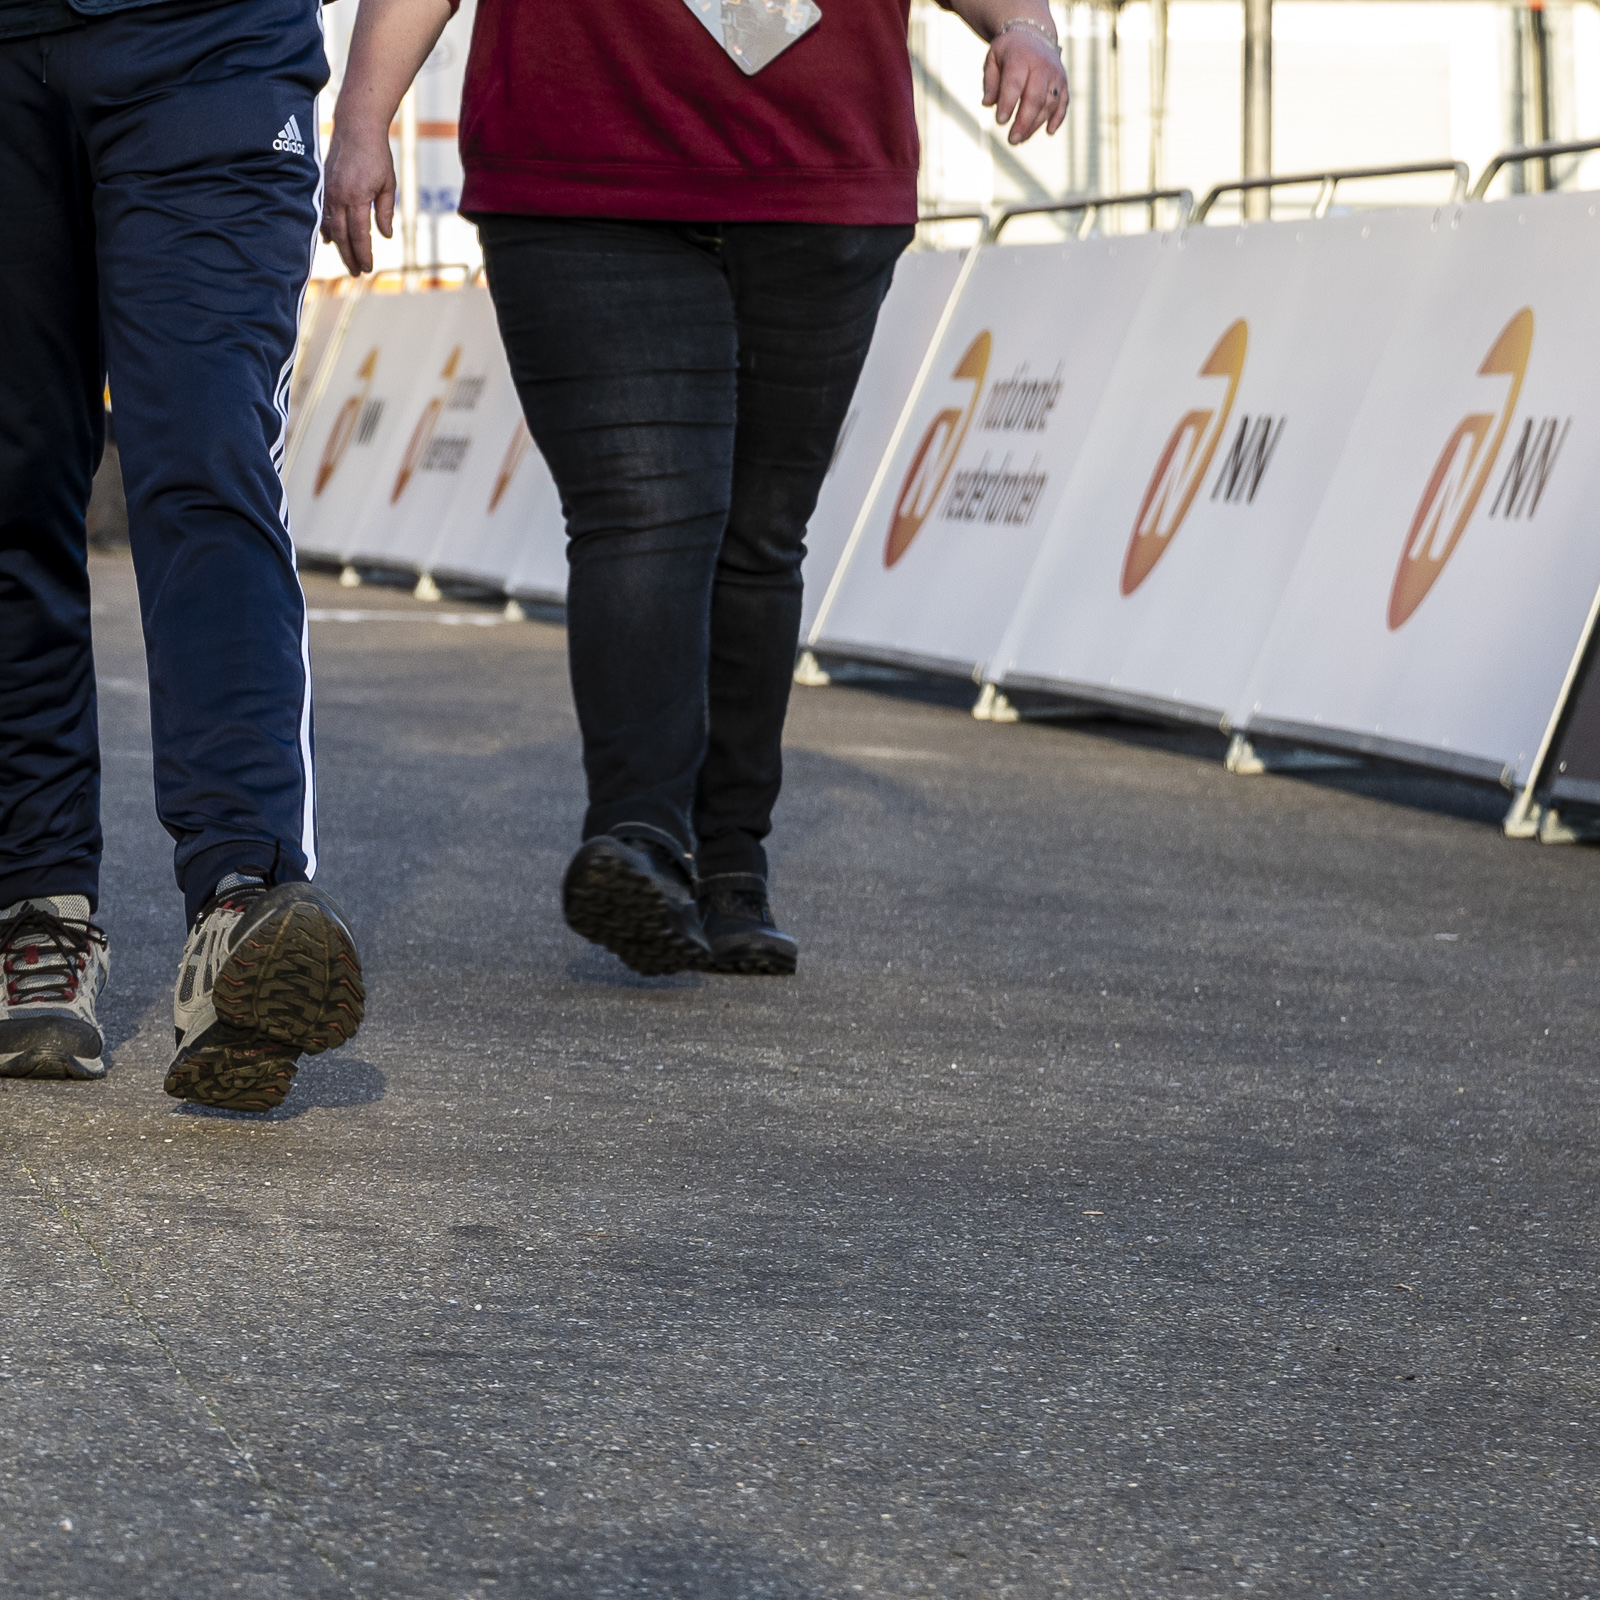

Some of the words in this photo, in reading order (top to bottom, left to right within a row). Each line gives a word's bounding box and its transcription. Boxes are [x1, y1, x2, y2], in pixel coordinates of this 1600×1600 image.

[272, 138, 305, 155] adidas
[1209, 413, 1288, 506] NN
[1487, 415, 1573, 521] NN
